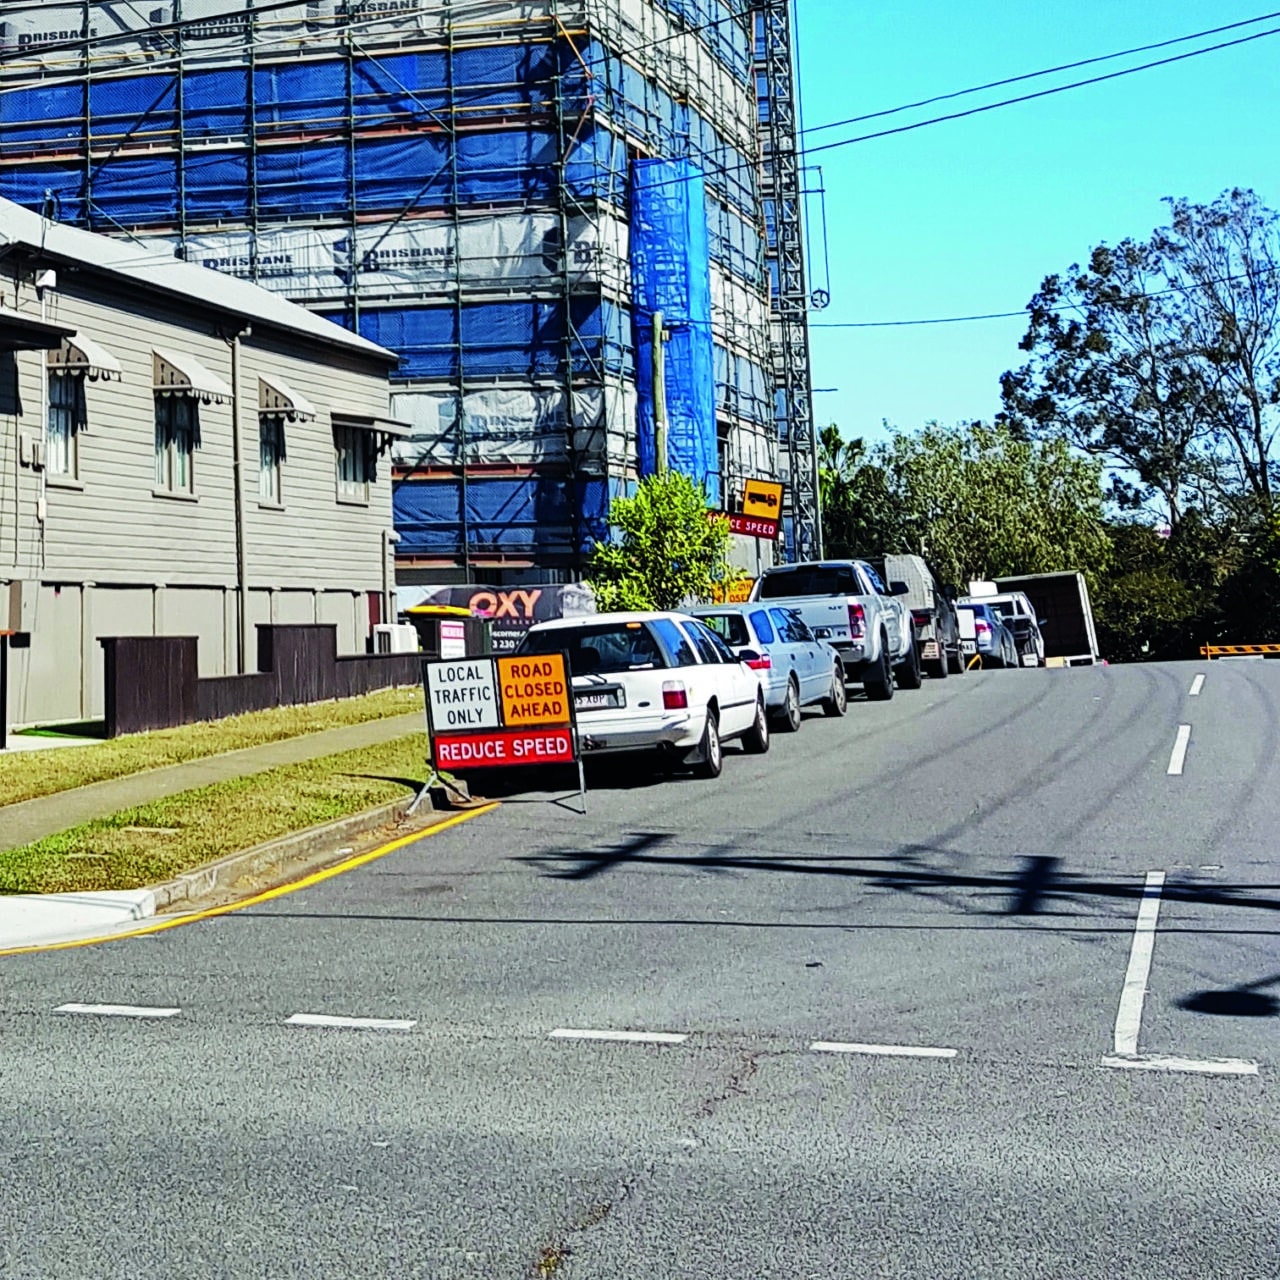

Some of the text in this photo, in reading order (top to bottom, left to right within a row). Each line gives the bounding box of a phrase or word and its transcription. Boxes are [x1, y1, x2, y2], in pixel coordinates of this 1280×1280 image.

[18, 27, 98, 51] BRISBAE
[745, 521, 775, 535] SPEED
[470, 589, 543, 619] OXY
[438, 665, 484, 683] LOCAL
[510, 662, 553, 679] ROAD
[434, 686, 491, 705] TRAFFIC
[504, 681, 564, 699] CLOSED
[447, 708, 483, 725] ONLY
[510, 701, 563, 719] AHEAD
[438, 737, 568, 761] REDUCE SPEED
